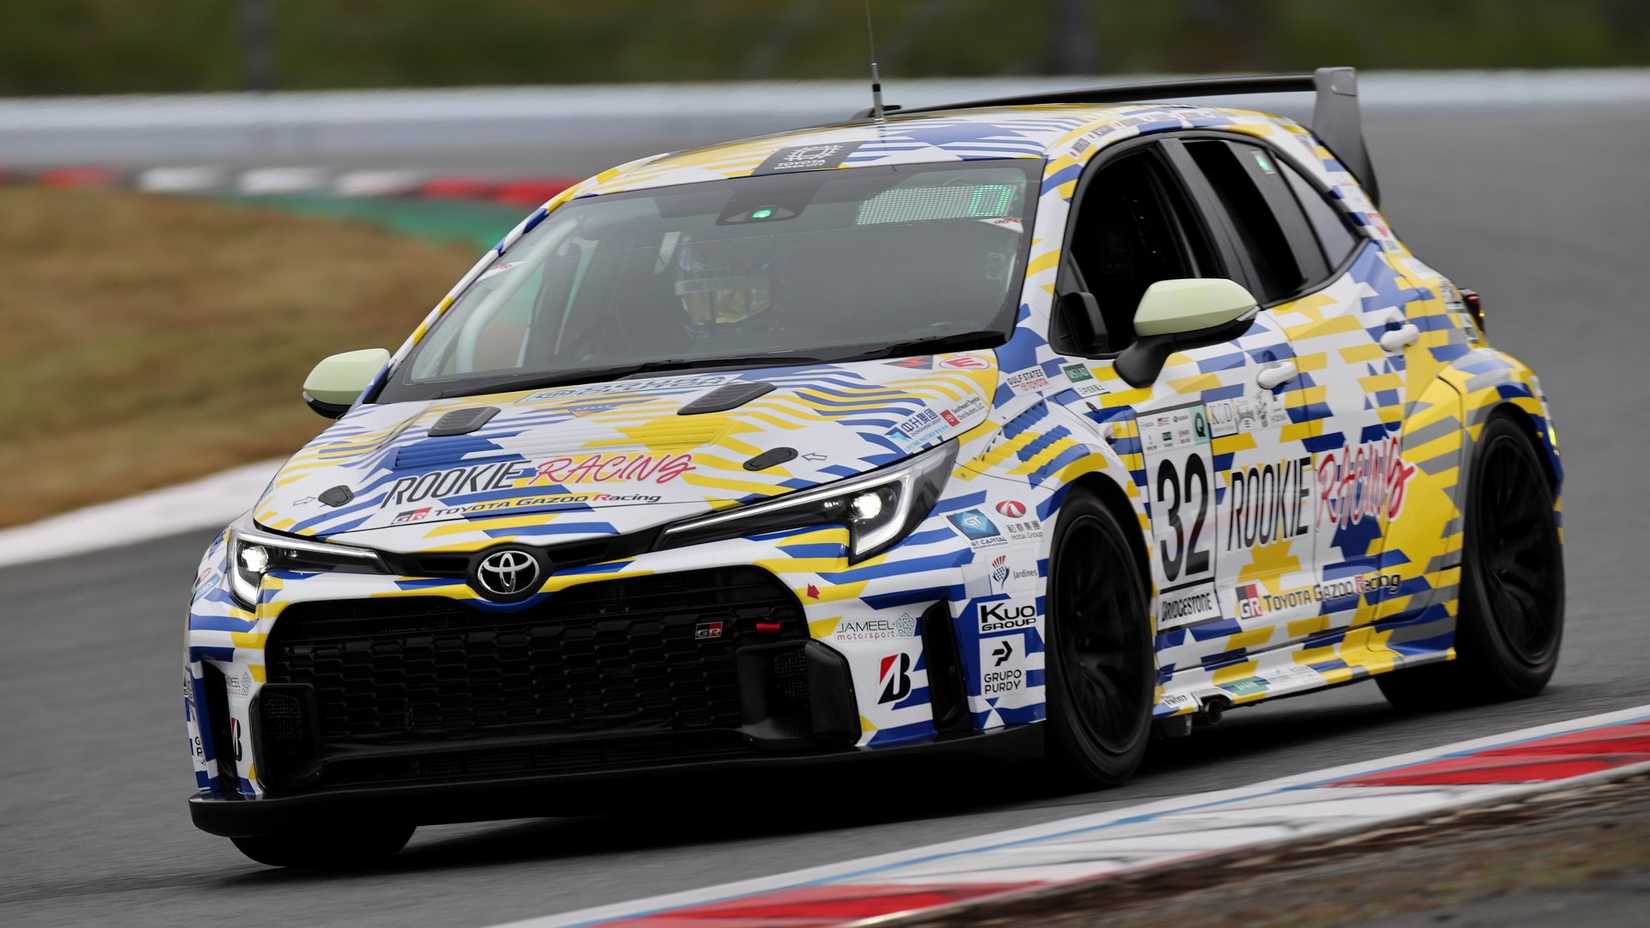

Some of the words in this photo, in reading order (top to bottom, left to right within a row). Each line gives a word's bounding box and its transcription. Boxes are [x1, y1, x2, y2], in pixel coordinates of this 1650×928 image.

[380, 460, 531, 509] ROOKIE
[529, 454, 697, 485] RACING
[1227, 456, 1312, 551] ROOKIE
[1315, 436, 1416, 530] RACING
[434, 500, 512, 517] TOYOTA
[516, 495, 588, 507] GAZOO
[592, 493, 662, 504] Racing
[1157, 452, 1210, 582] 32
[1161, 592, 1213, 622] BRIDGESTONE
[1240, 597, 1263, 620] GR
[1263, 590, 1312, 613] TOYOTA
[1312, 581, 1354, 602] GAZOO
[1355, 574, 1401, 595] Racing
[837, 619, 895, 634] JAMEEL
[837, 630, 896, 641] motorsport
[981, 617, 1037, 632] GROUP
[984, 669, 1022, 683] GRUPO
[984, 680, 1021, 694] PURDY
